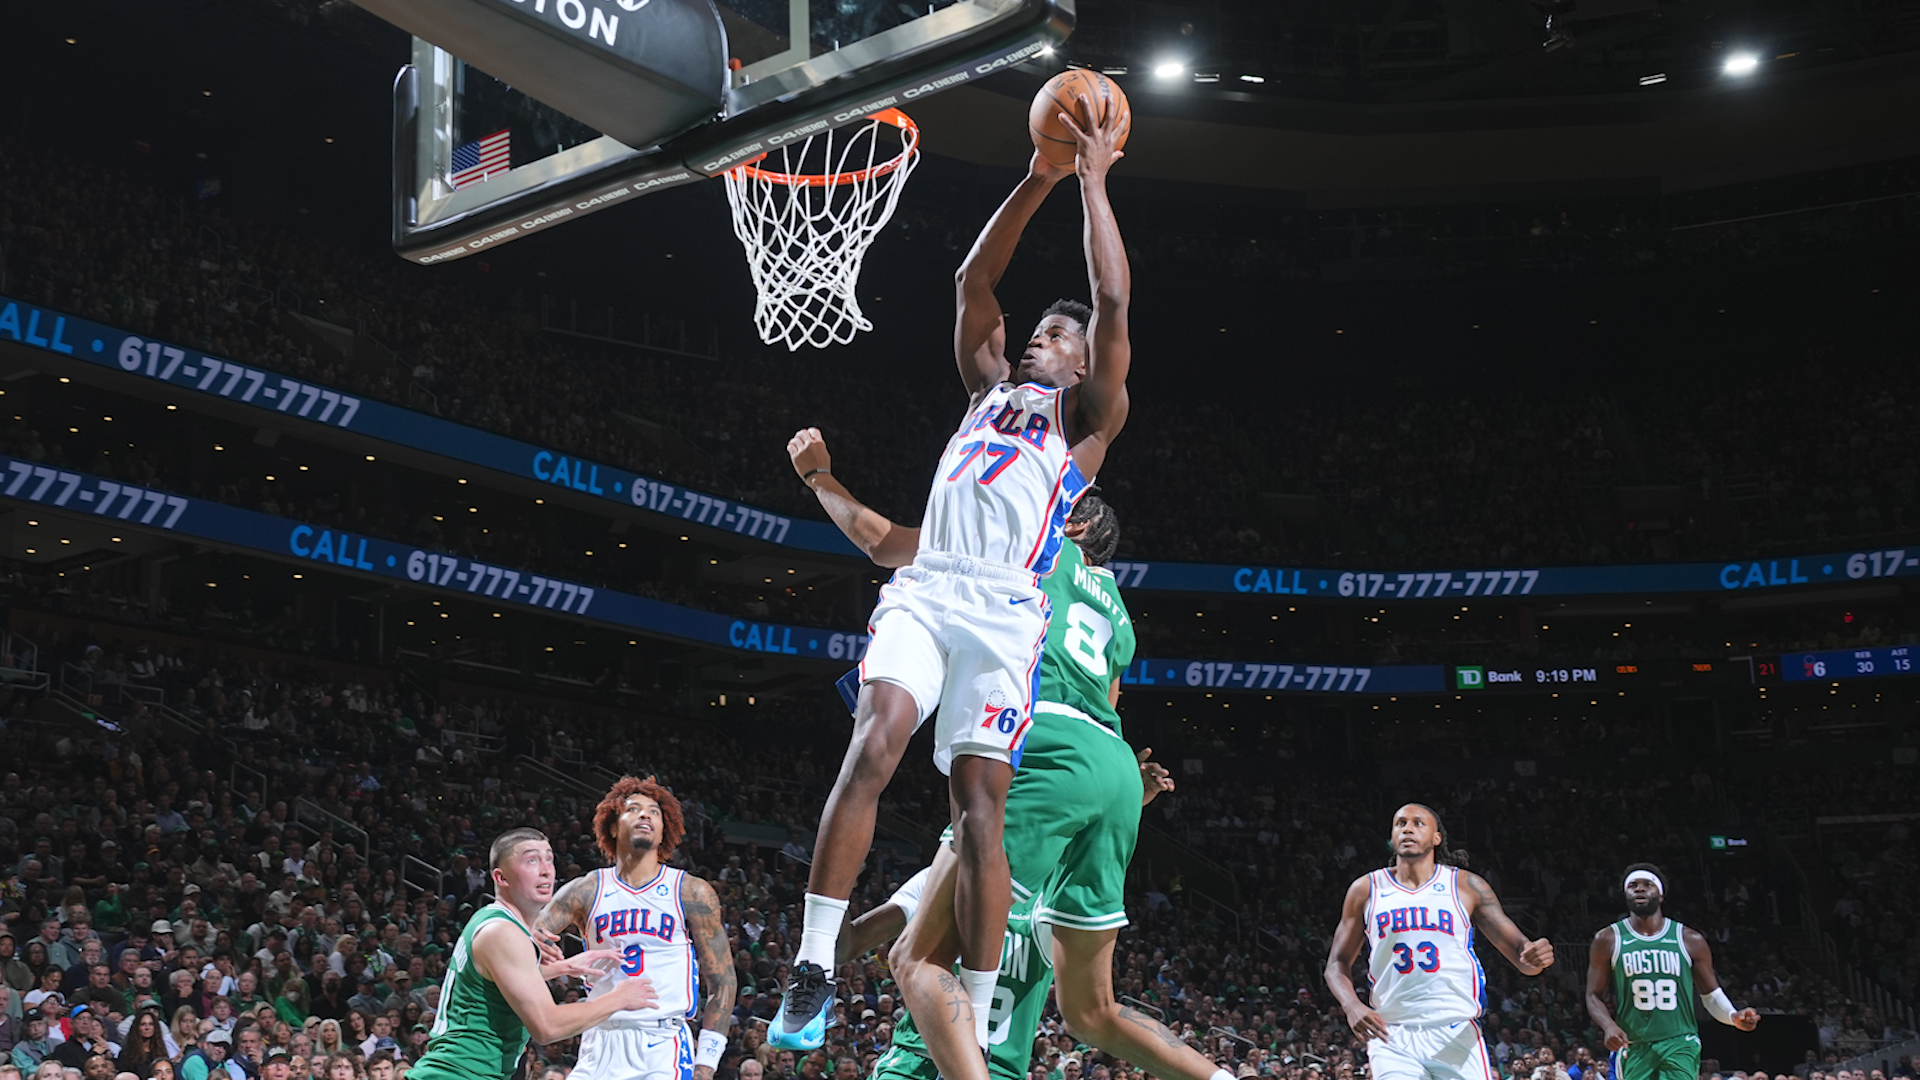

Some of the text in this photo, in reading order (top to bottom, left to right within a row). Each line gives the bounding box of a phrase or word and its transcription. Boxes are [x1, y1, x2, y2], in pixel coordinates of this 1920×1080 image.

[932, 70, 970, 90] ENERGY
[861, 95, 898, 113] ENERGY
[795, 119, 829, 137] ENERGY
[731, 142, 763, 160] ENERGY
[659, 172, 690, 184] ENERGY
[118, 336, 361, 428] 617-777-7777
[947, 440, 1020, 486] 77
[533, 451, 791, 544] CALL 617-777-7777
[290, 525, 594, 615] CALL 617-777-7777
[1233, 568, 1540, 598] CALL 617-777-7777
[1720, 550, 1920, 589] CALL 617-
[1073, 562, 1129, 627] MINOTT
[729, 620, 798, 655] CALL
[1063, 601, 1114, 677] 8
[1185, 661, 1372, 692] 617-777-7777
[1458, 668, 1597, 685] TD Bank 9:19 PM
[1759, 663, 1776, 676] 21
[1857, 660, 1874, 673] 30
[1894, 658, 1911, 671] 15
[981, 701, 1018, 734] 76
[595, 908, 676, 944] PHILA
[1376, 906, 1455, 940] PHILA
[621, 944, 645, 977] 9
[1393, 941, 1441, 974] 33
[1622, 948, 1681, 978] BOSTON
[1631, 978, 1678, 1011] 88
